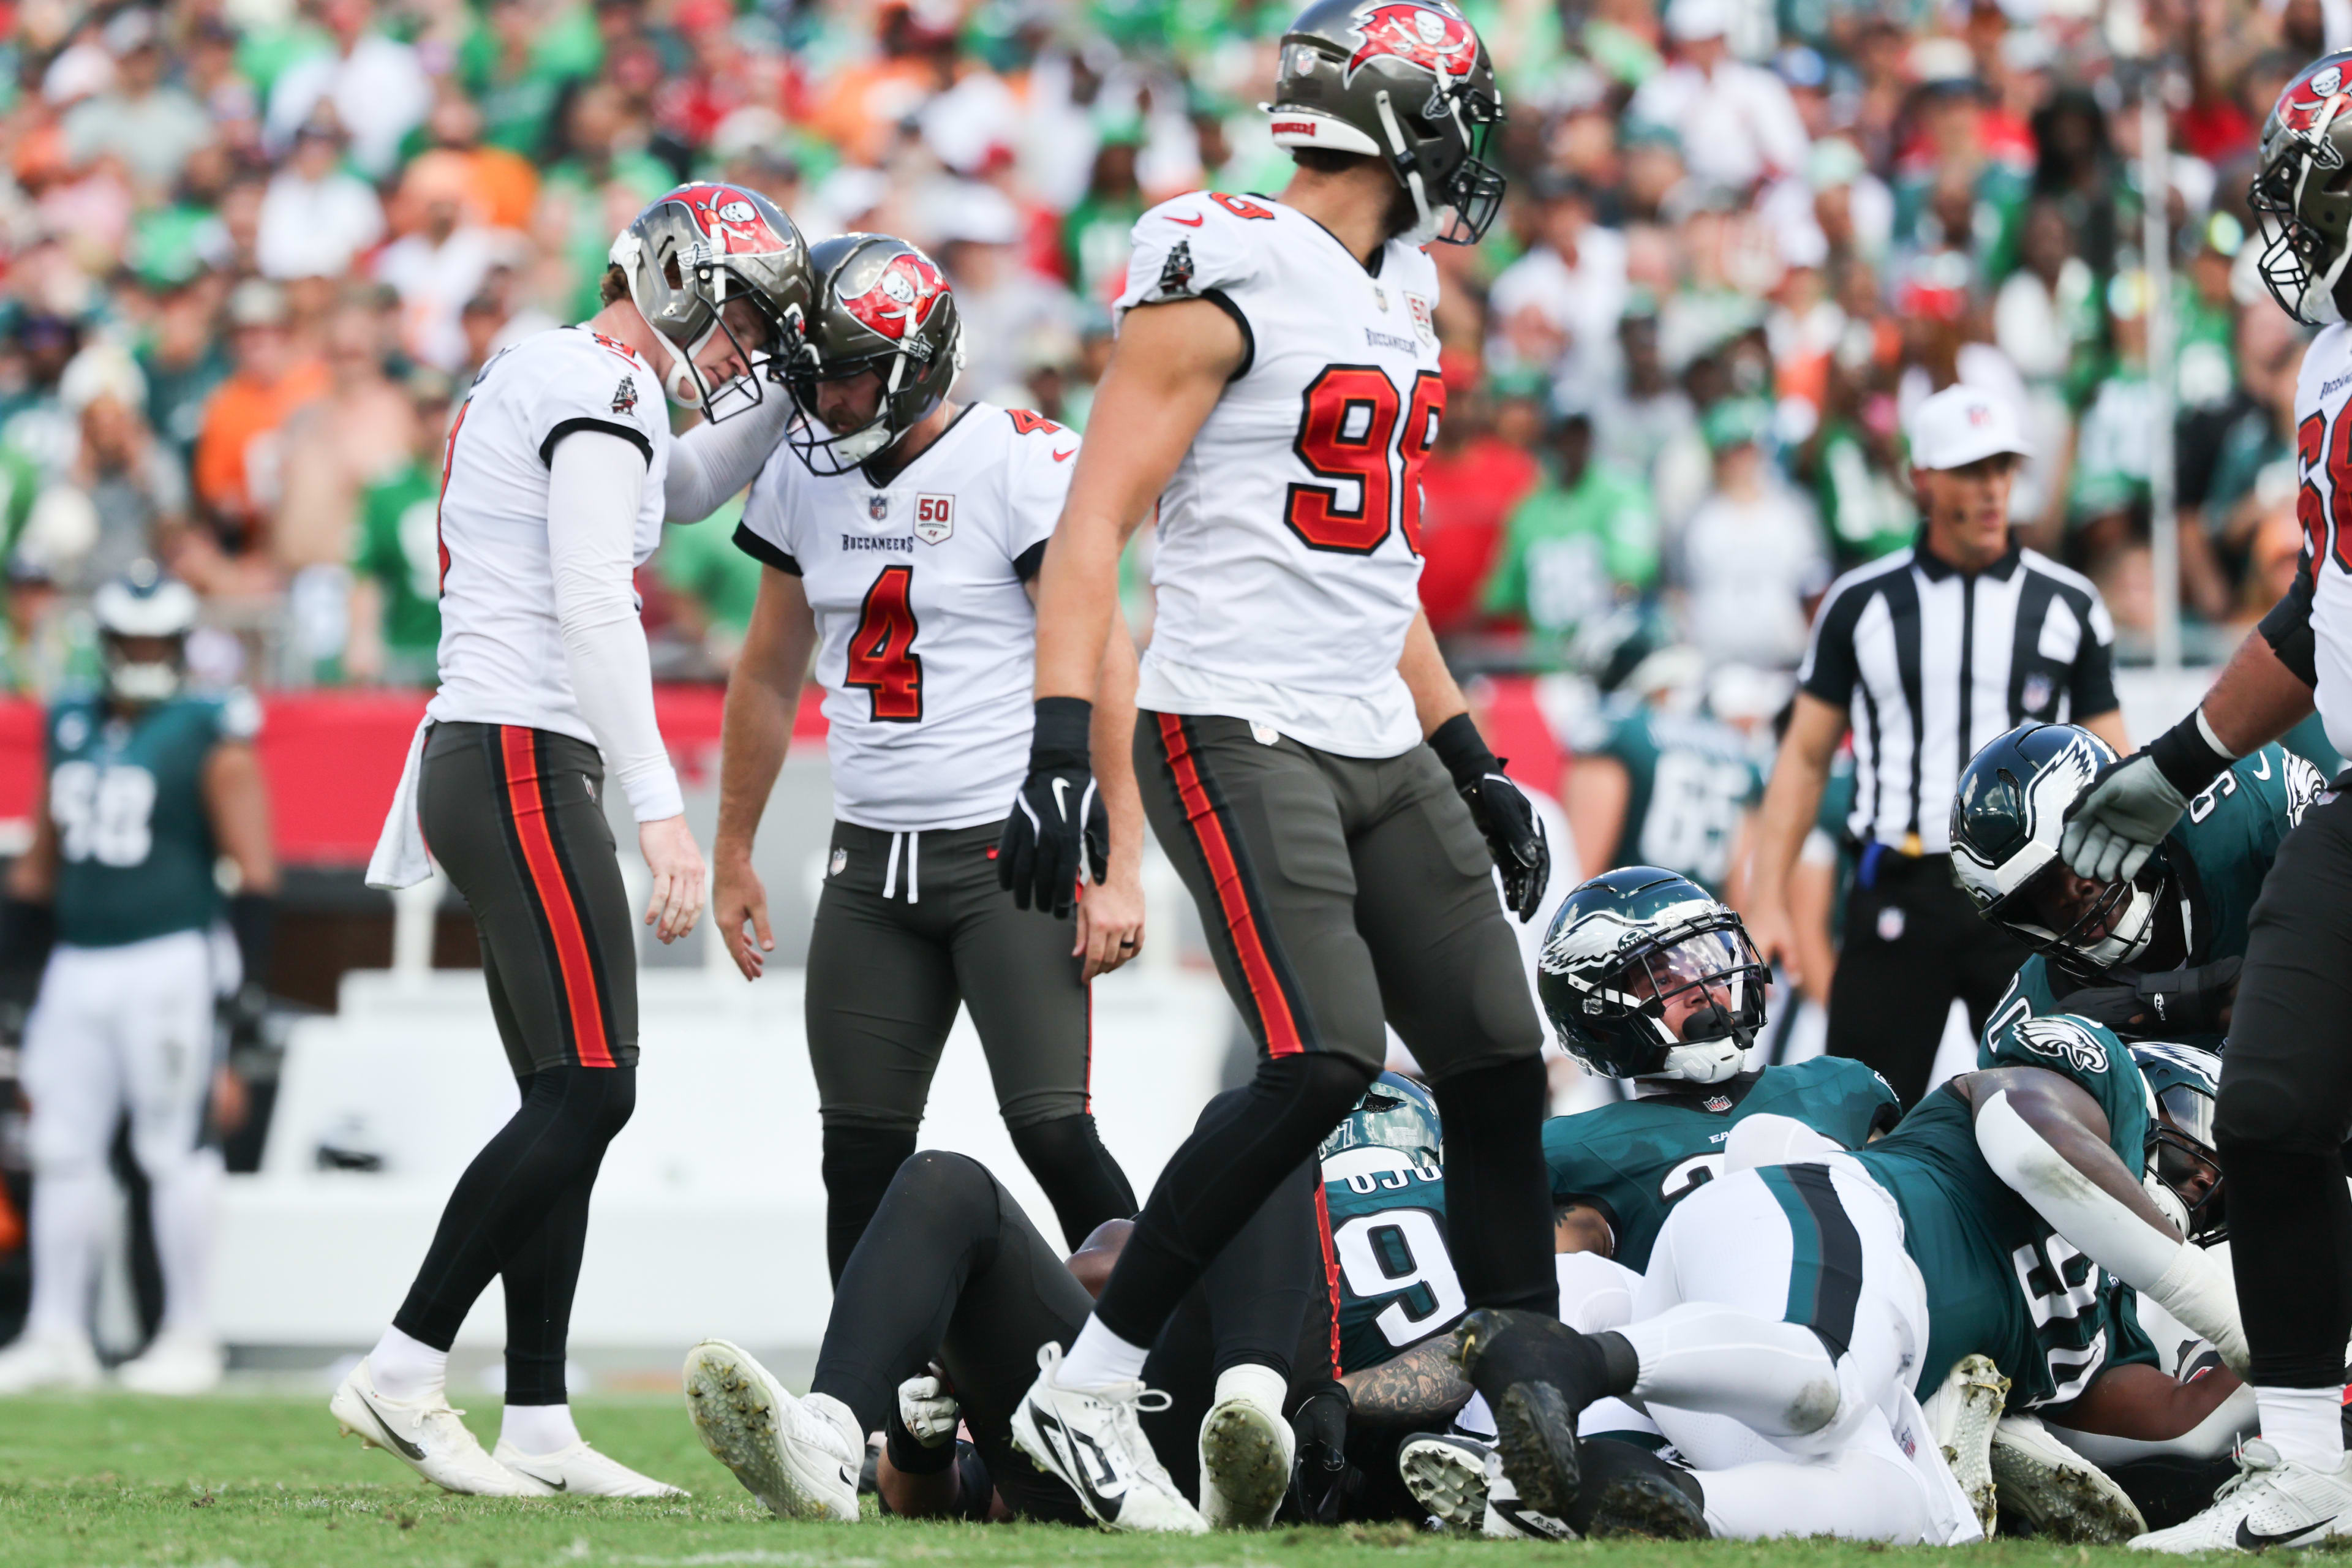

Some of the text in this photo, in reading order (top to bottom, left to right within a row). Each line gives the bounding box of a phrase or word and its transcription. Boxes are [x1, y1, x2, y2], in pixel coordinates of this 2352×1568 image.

[842, 534, 913, 552] BUCCANEERS
[919, 499, 949, 522] 50
[842, 565, 923, 723] 4
[1333, 1207, 1469, 1348] 9
